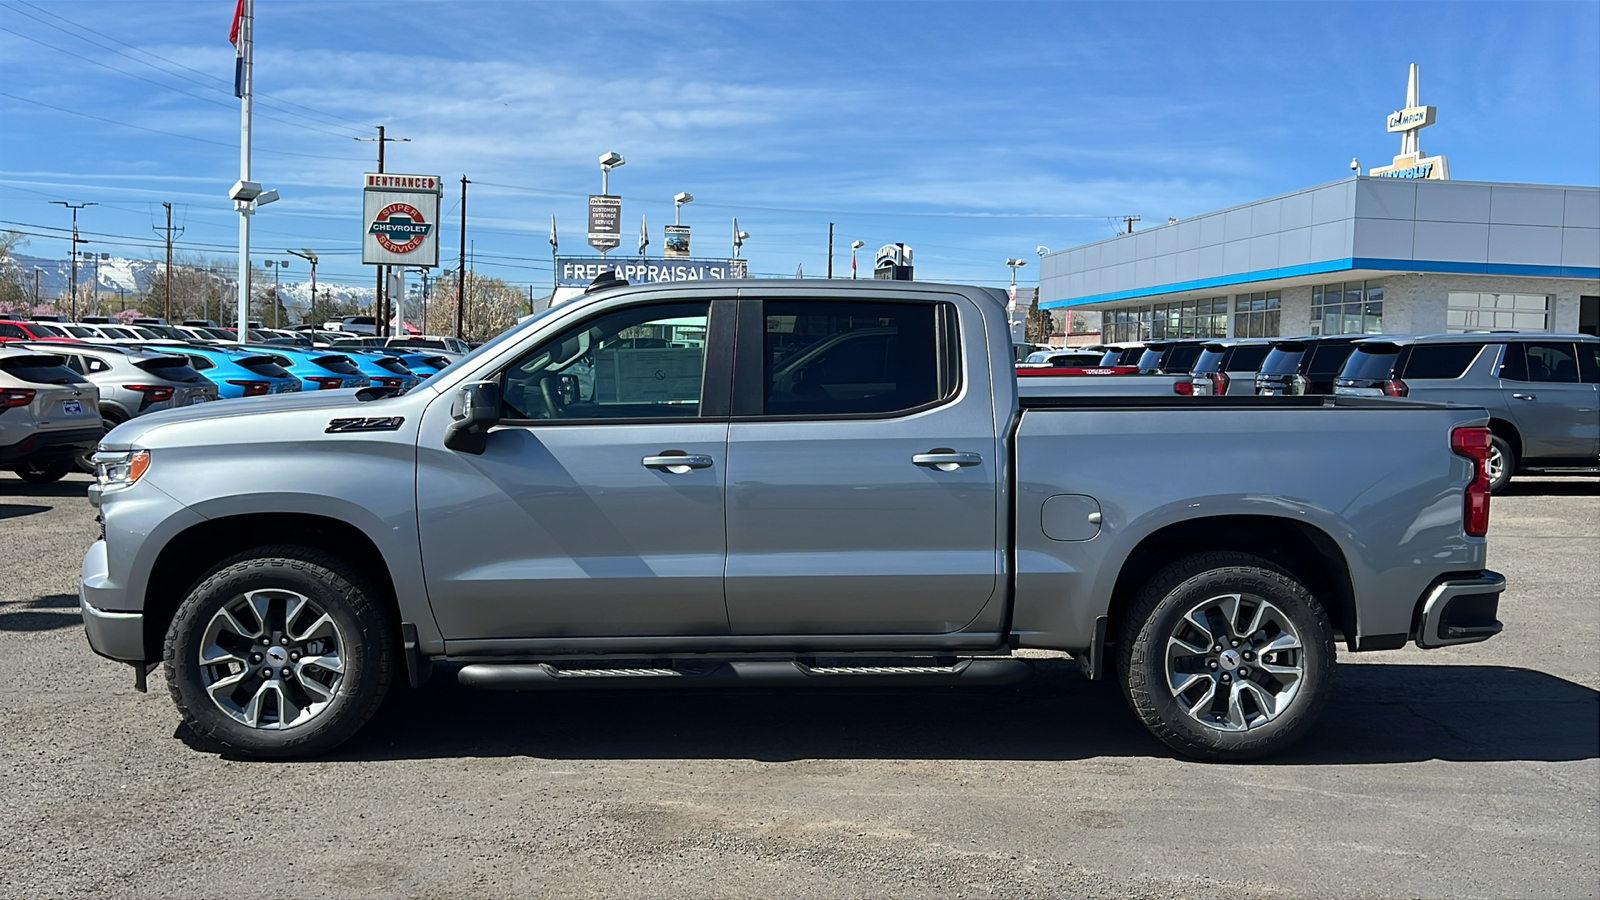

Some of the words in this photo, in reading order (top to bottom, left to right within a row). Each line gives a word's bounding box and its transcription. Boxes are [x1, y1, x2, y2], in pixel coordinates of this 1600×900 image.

[375, 176, 427, 189] ENTRANCE
[382, 204, 418, 217] SUPER
[373, 224, 427, 233] CHEVROLET
[378, 236, 421, 253] SERVICE
[324, 416, 406, 434] Z71
